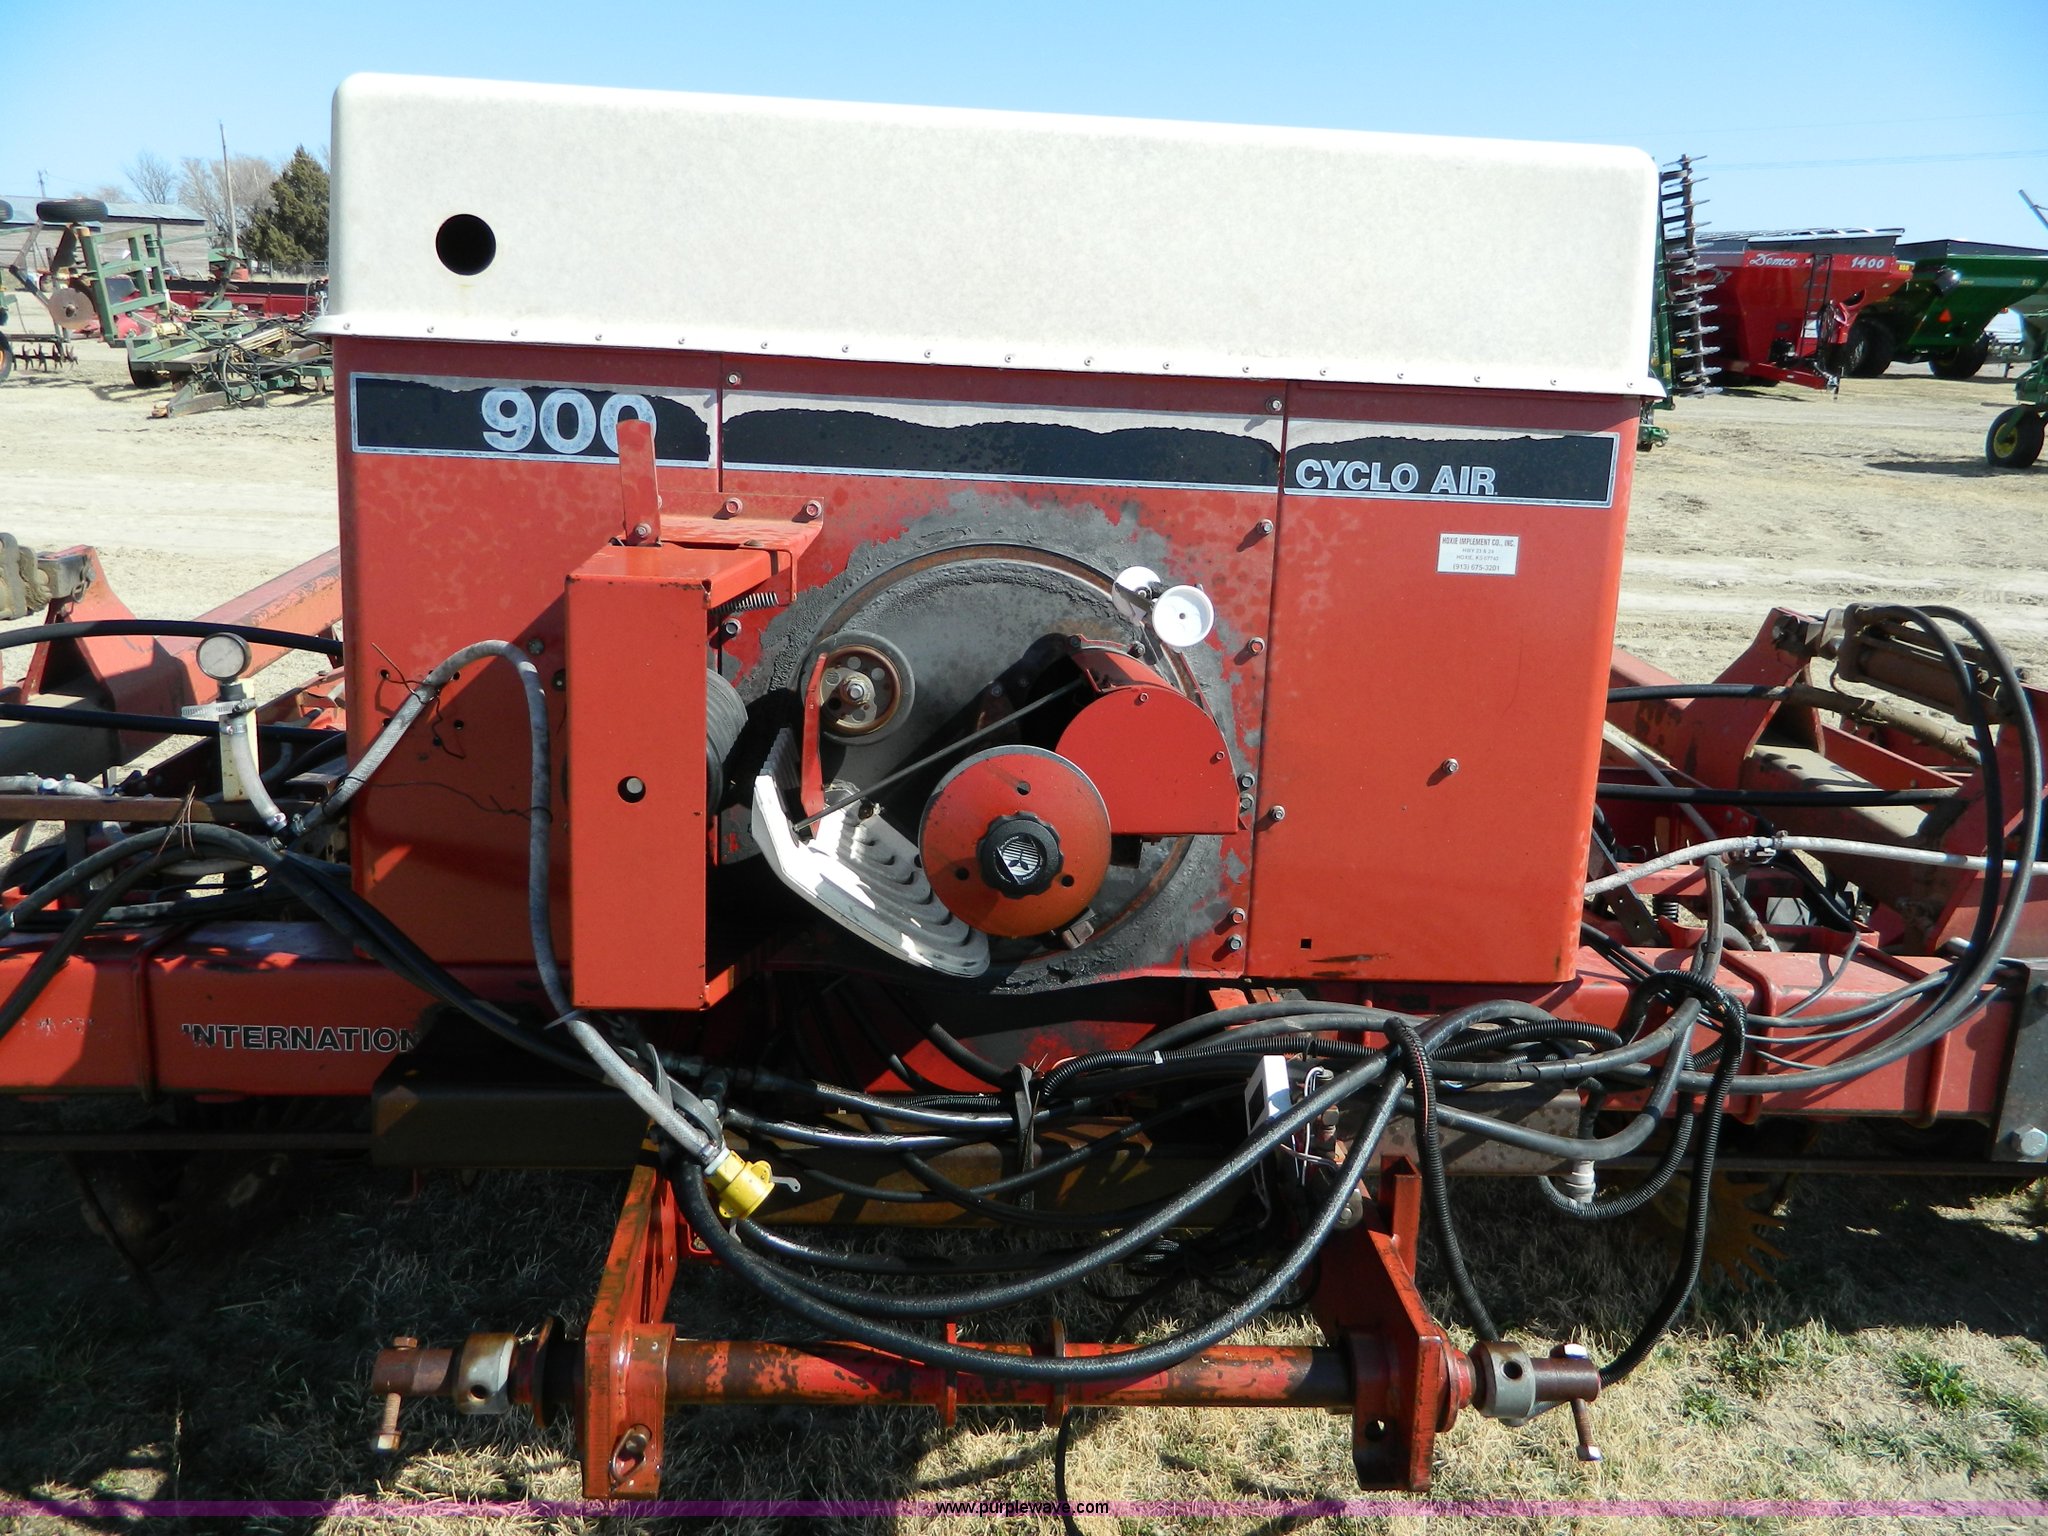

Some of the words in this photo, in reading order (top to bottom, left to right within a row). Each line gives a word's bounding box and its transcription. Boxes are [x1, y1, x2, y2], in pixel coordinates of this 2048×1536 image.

[1749, 253, 1798, 267] Demco
[1851, 256, 1885, 269] 1400
[481, 387, 657, 455] 900
[1295, 458, 1419, 492] CYCLO
[1442, 537, 1458, 545] HOXIE
[1459, 538, 1490, 546] IMPLEMENT
